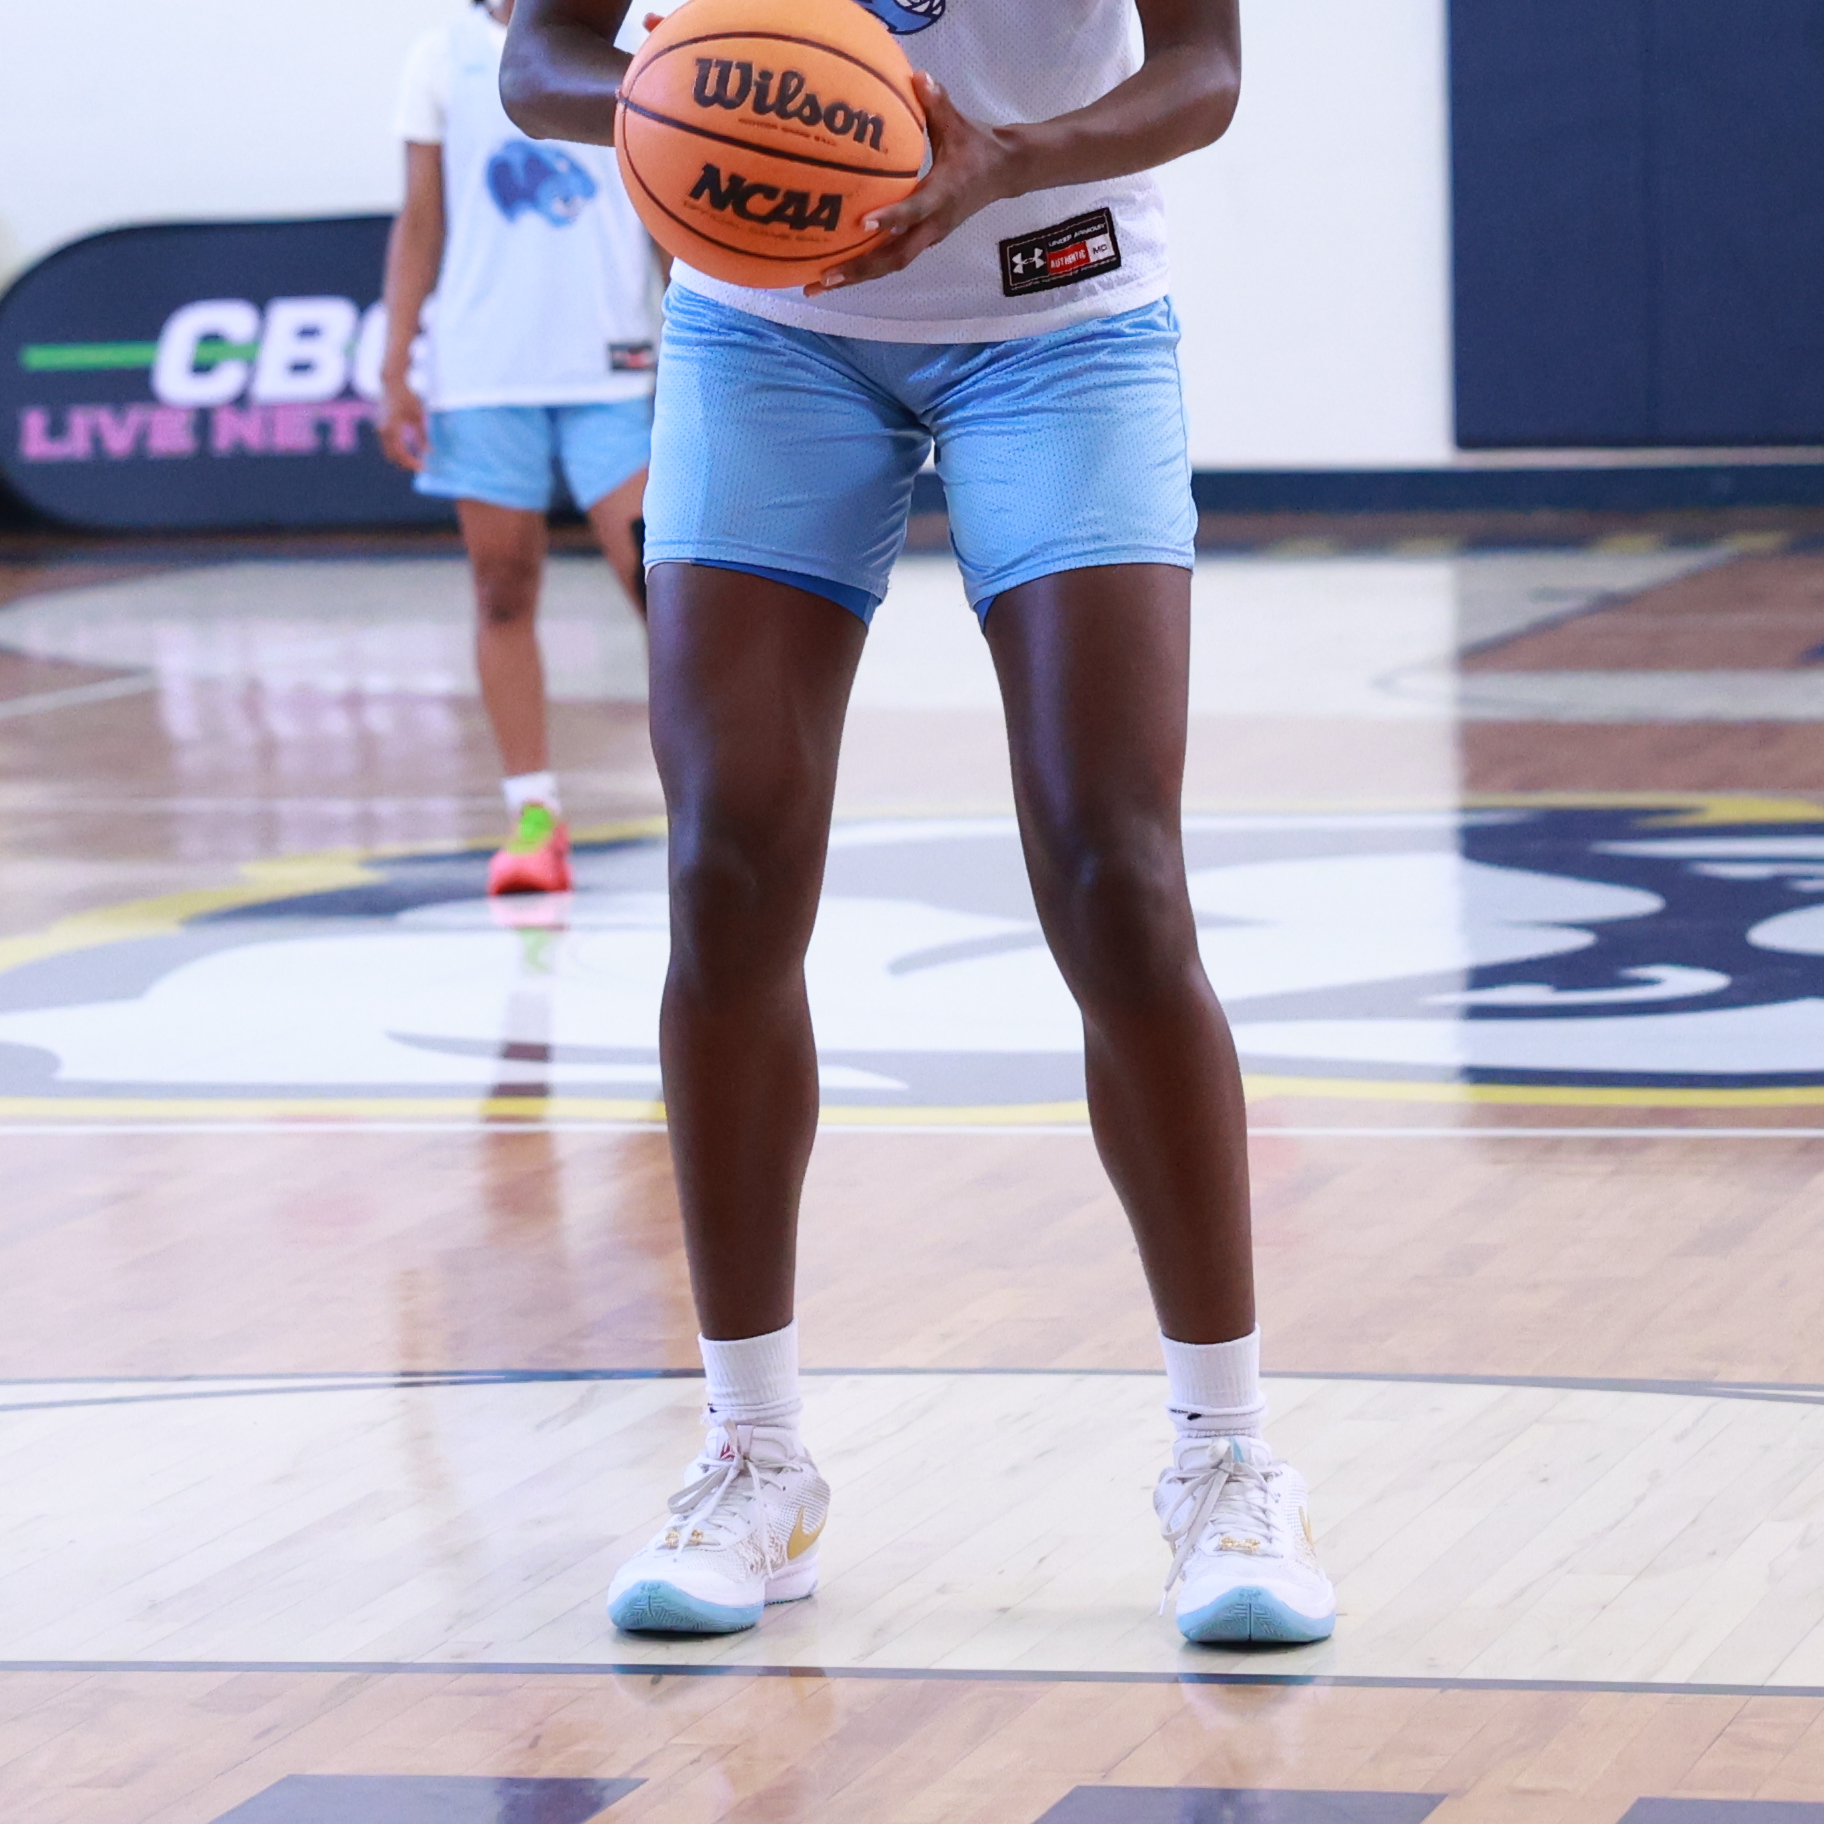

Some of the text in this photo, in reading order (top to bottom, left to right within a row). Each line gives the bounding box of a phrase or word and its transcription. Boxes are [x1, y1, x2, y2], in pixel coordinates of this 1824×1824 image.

[693, 58, 883, 152] Wilson
[687, 162, 844, 232] NCAA
[1050, 250, 1086, 268] AUTHENTIC
[21, 402, 379, 461] LIVE NET
